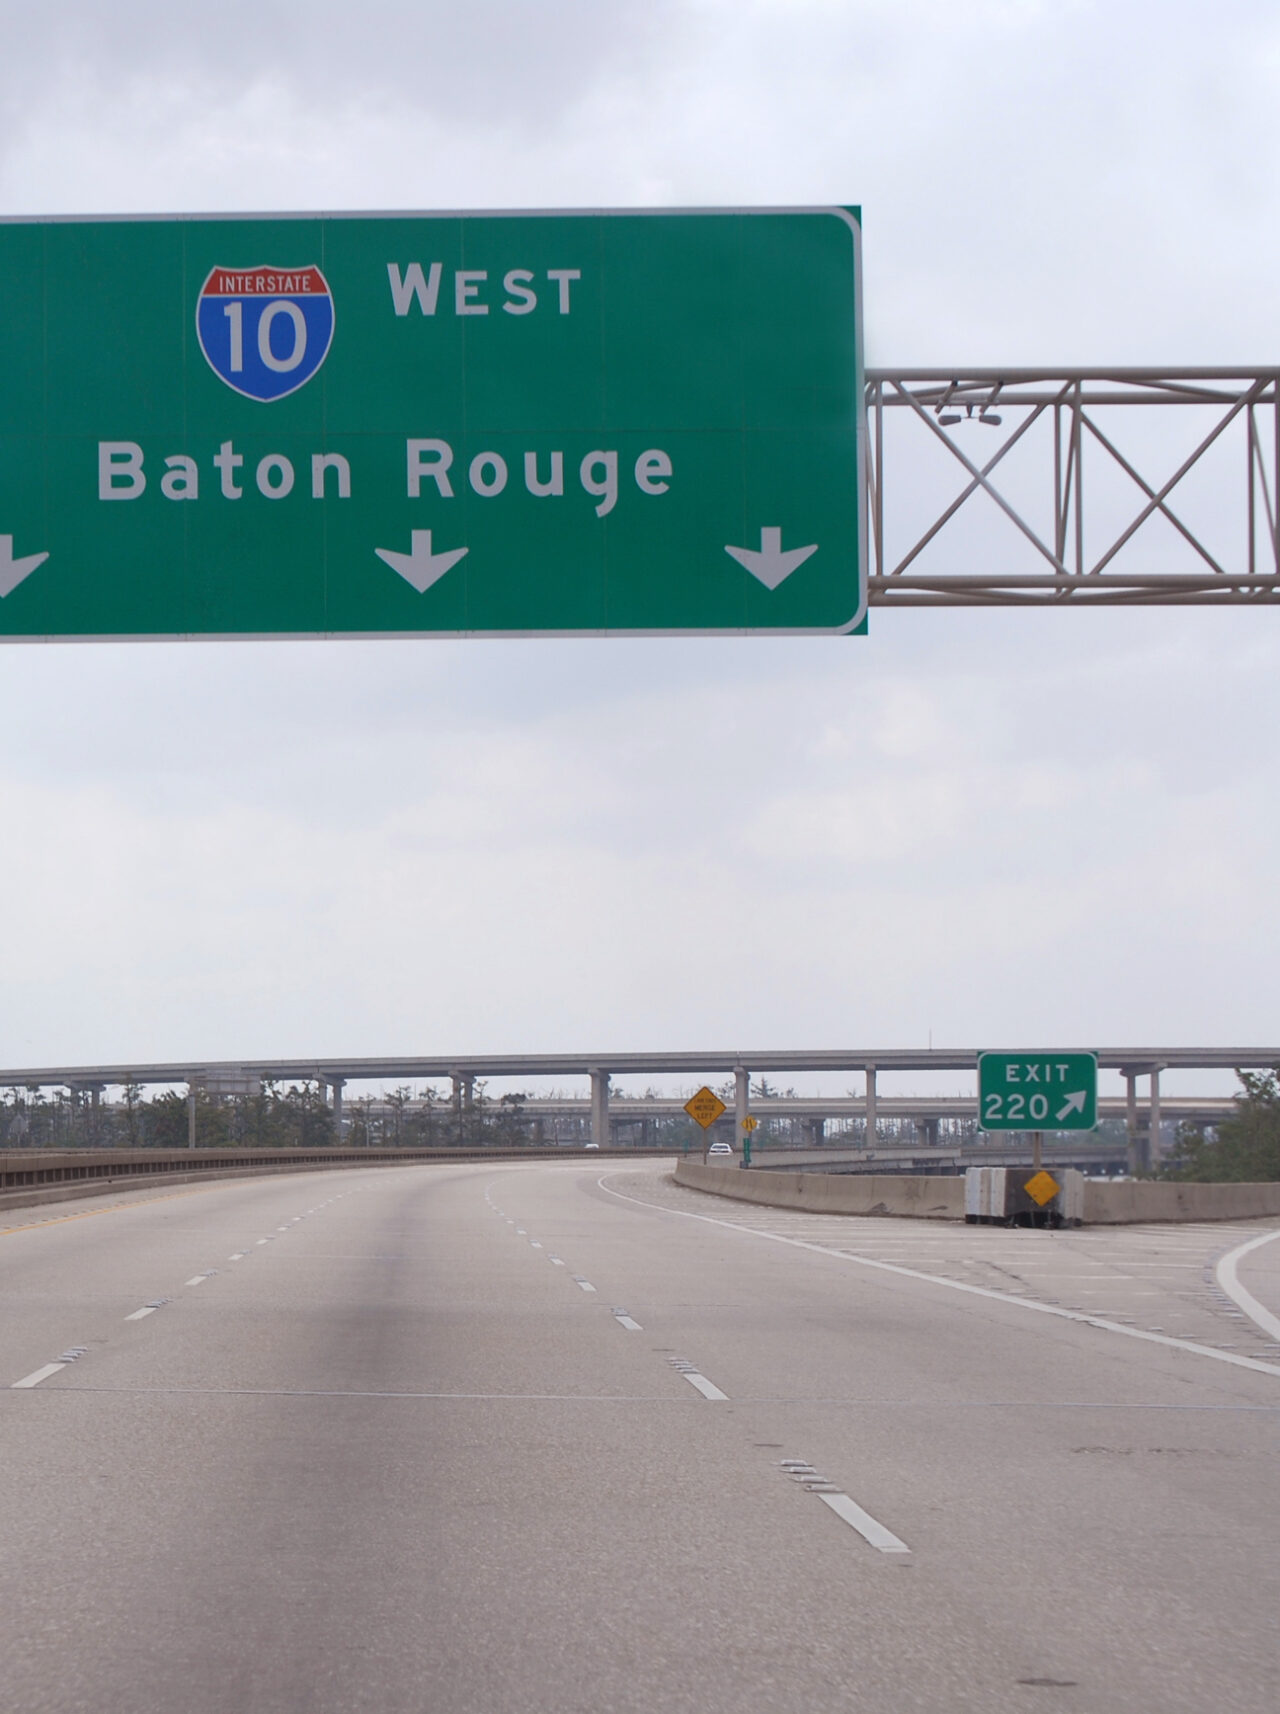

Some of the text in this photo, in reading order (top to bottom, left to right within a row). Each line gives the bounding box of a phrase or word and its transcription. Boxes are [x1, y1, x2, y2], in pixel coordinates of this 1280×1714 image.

[219, 275, 311, 292] INTERSTATE
[387, 263, 581, 316] WEST
[223, 299, 307, 373] 10
[98, 438, 674, 518] Baton Rouge
[1006, 1064, 1069, 1082] EXIT
[985, 1093, 1048, 1120] 220
